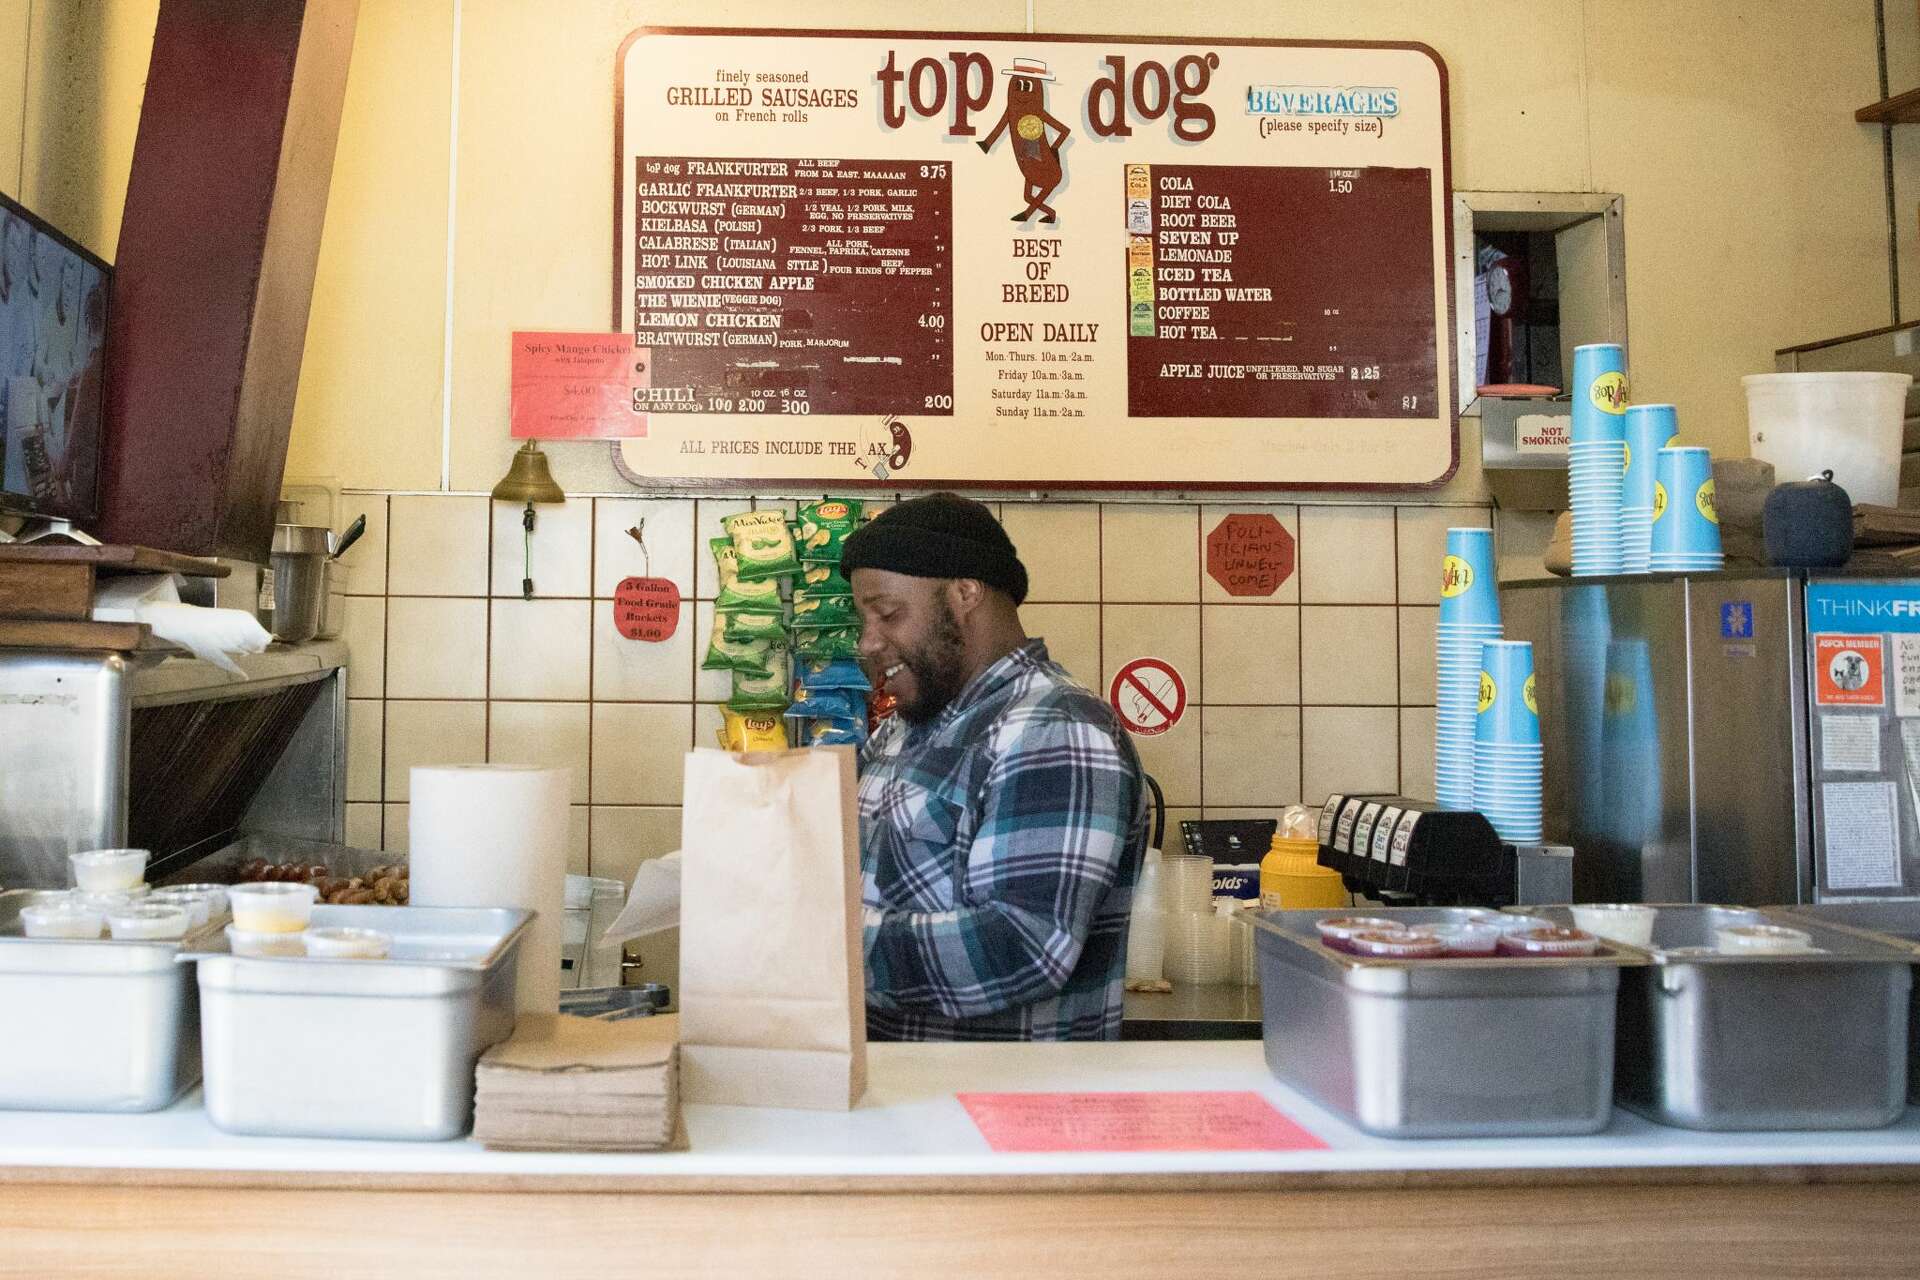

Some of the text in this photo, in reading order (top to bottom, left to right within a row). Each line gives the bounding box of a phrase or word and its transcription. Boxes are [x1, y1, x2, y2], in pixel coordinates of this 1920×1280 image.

[716, 70, 808, 84] finely seasoned
[667, 87, 857, 108] GRILLED SAUSAGES
[877, 50, 1219, 141] top dog
[1248, 91, 1397, 114] BEVERAGES
[716, 110, 808, 122] on French rolls
[1260, 117, 1383, 138] (please specify size)
[664, 164, 680, 175] dog
[688, 162, 788, 176] FRANKFURTER
[795, 170, 818, 178] FROM
[920, 165, 946, 179] 3.75
[639, 183, 797, 198] GARLIC FRANKFURTER
[1160, 177, 1194, 190] COLA
[1329, 180, 1352, 193] 1.50
[1161, 196, 1231, 209] DIET COLA
[642, 201, 785, 219] BOCKWURST (GERMAN)
[641, 218, 761, 234] KIELBASA (POLISH)
[1161, 214, 1196, 227] ROOT
[1201, 215, 1236, 228] BEER
[639, 236, 776, 253] CALABRESE (ITALIAN)
[1160, 232, 1239, 245] SEVEN UP
[1013, 239, 1061, 257] BEST
[642, 255, 670, 267] HOT
[675, 255, 708, 269] LINK
[1160, 249, 1232, 263] LEMONADE
[1026, 262, 1051, 280] OF
[1158, 268, 1232, 282] ICED TEA
[636, 275, 814, 290] SMOKED CHICKEN APPLE
[1002, 284, 1069, 302] BREED
[1160, 288, 1272, 301] BOTTLED WATER
[638, 294, 666, 307] THE
[671, 294, 721, 307] WIENIE
[1159, 307, 1209, 319] COFFEE
[639, 313, 944, 328] LEMON CHICKEN 4.00
[637, 332, 777, 347] BRATWURST (GERMAN)
[981, 323, 1099, 342] OPEN DAILY
[1160, 326, 1217, 339] HOT TEA
[525, 344, 551, 354] Spicy
[556, 344, 589, 355] Mango
[998, 370, 1027, 382] Friday
[1160, 364, 1202, 377] APPLE
[1208, 365, 1244, 378] JUICE
[634, 388, 695, 402] CHILI
[992, 389, 1032, 401] Saturday
[782, 400, 810, 414] 300
[925, 395, 952, 409] 200
[996, 407, 1029, 419] Sunday
[680, 440, 705, 453] ALL
[712, 441, 759, 454] PRICES
[765, 442, 822, 455] INCLUDE
[829, 442, 856, 455] THE
[626, 582, 669, 592] 5 Gallon
[626, 612, 667, 622] Buckets
